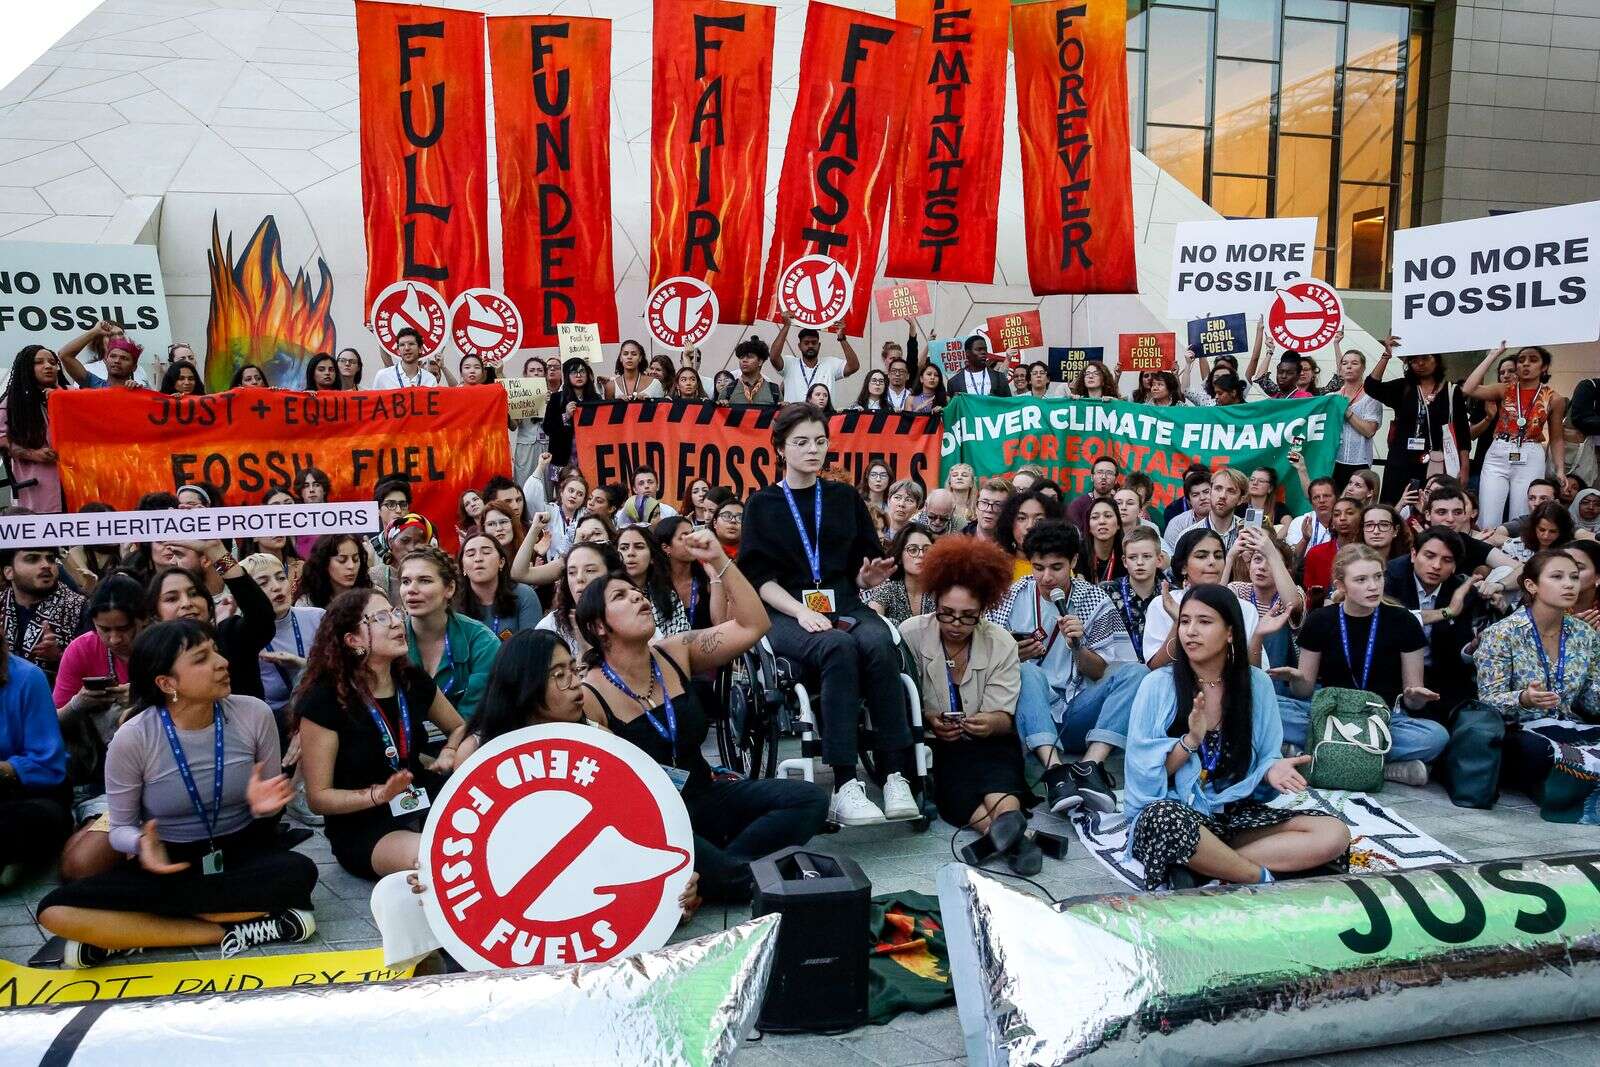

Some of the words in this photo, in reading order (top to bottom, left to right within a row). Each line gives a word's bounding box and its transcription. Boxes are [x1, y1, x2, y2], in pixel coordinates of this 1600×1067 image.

[683, 14, 746, 272] FAIR
[802, 23, 896, 256] FAST
[919, 0, 973, 272] EMINIST
[1055, 4, 1094, 271] FOREVER
[397, 21, 452, 281] FULL
[531, 22, 576, 336] FUNDED
[1180, 244, 1217, 264] NO
[1224, 242, 1306, 263] MORE
[1403, 254, 1457, 284] NO
[1470, 237, 1591, 276] MORE
[54, 271, 156, 296] MORE
[785, 268, 804, 294] #END
[893, 287, 910, 298] END
[652, 286, 676, 310] #END
[786, 298, 816, 322] FOSSIL
[821, 289, 844, 321] FUELS
[888, 297, 919, 309] FOSSIL
[891, 305, 919, 318] FUELS
[1306, 286, 1339, 316] FUELS
[1403, 276, 1589, 321] FOSSILS
[0, 304, 160, 332] FOSSILS
[378, 310, 392, 343] #END
[428, 304, 443, 344] FUELS
[492, 299, 517, 333] FUELS
[651, 313, 675, 344] FOSSIL
[1005, 316, 1022, 327] END
[1207, 320, 1226, 331] END
[681, 317, 710, 344] FUELS
[1000, 326, 1031, 339] FOSSIL
[1002, 338, 1031, 350] FUELS
[1138, 337, 1156, 347] END
[1200, 330, 1235, 344] FOSSIL
[1274, 325, 1300, 349] #END
[1303, 321, 1338, 349] FOSSIL
[941, 351, 968, 363] FOSSI
[946, 341, 963, 351] END
[1068, 350, 1086, 361] END
[1131, 347, 1163, 358] FOSSIL
[1203, 341, 1234, 354] FUELS
[1133, 358, 1162, 369] FUELS
[147, 393, 237, 426] JUST
[284, 390, 441, 426] EQUITABLE
[941, 405, 1042, 457] DELIVER
[1050, 405, 1175, 446] CLIMATE
[1180, 413, 1327, 450] FINANCE
[352, 444, 445, 488] FUEL
[1003, 434, 1060, 466] FOR
[1065, 435, 1231, 479] EQUITABE
[595, 442, 666, 500] END
[0, 521, 37, 541] WE
[42, 519, 91, 539] ARE
[96, 515, 212, 537] HERITAGE
[217, 508, 369, 532] PROTECTORS
[496, 749, 600, 790] #END
[441, 786, 495, 922] FOSSIL
[480, 917, 618, 966] FUELS
